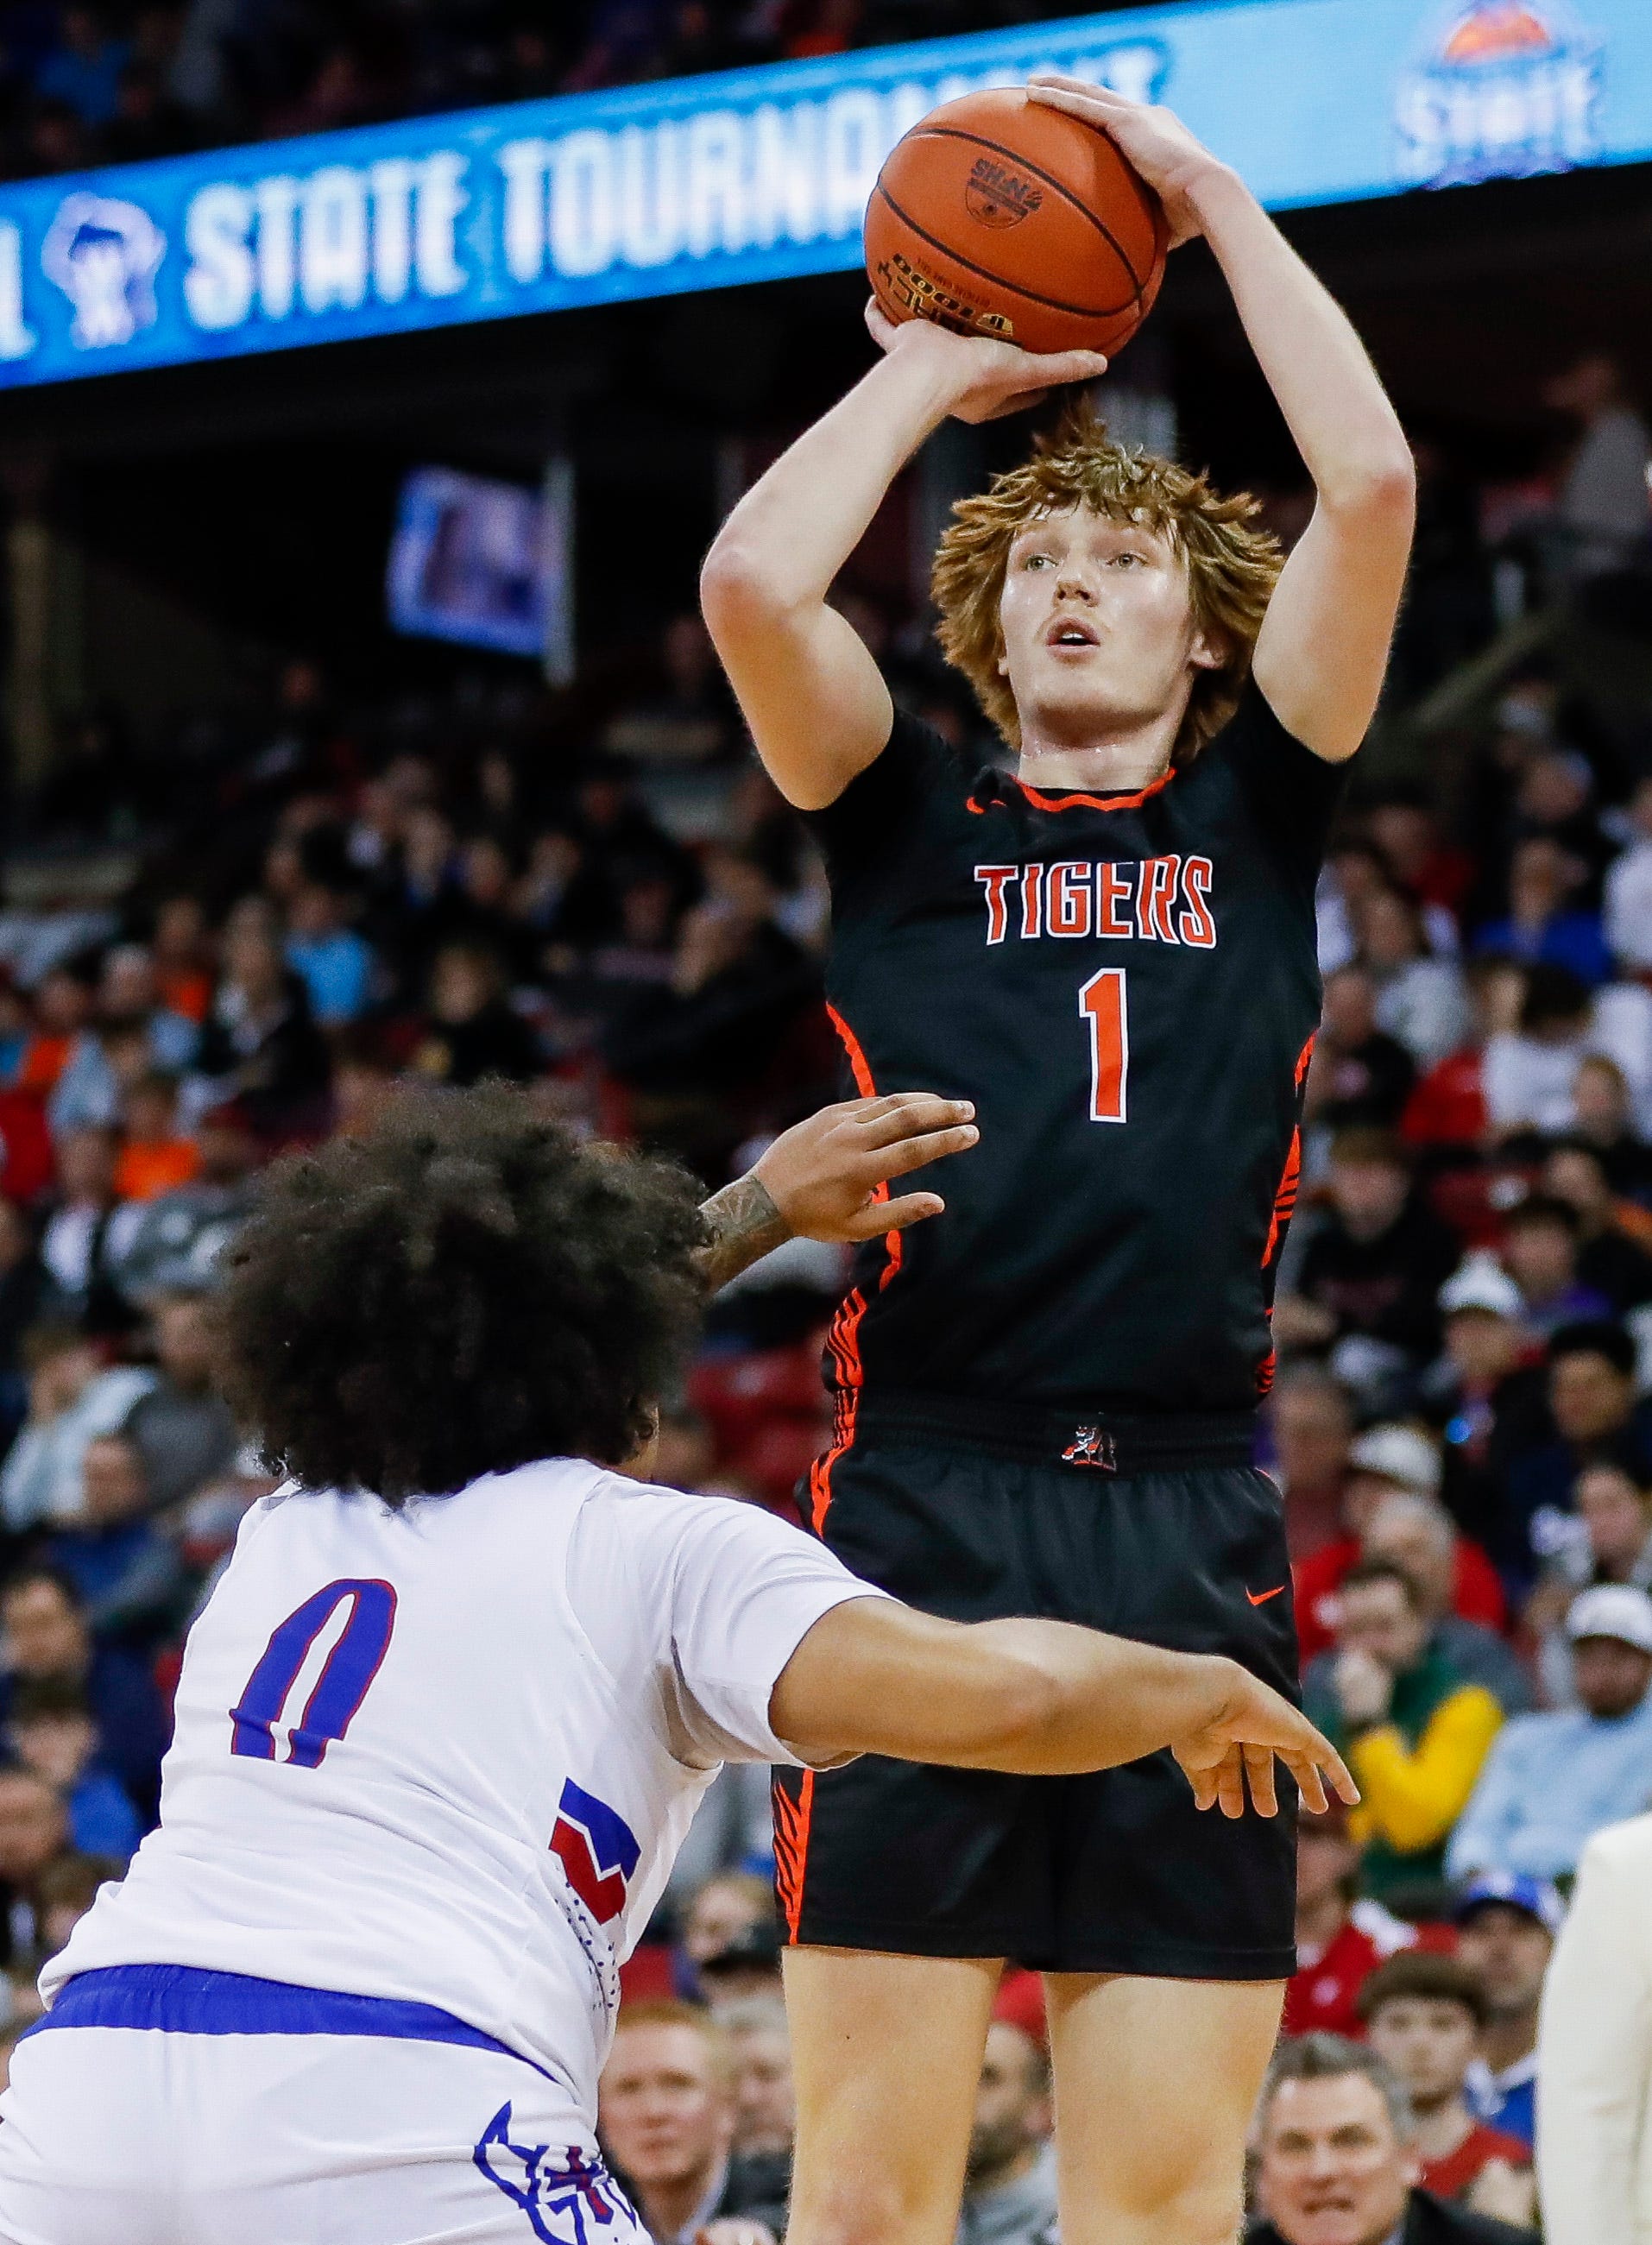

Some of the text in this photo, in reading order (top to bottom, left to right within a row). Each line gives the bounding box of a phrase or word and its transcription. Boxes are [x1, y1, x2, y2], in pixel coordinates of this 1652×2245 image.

[182, 148, 470, 335] STATE
[974, 854, 1217, 949] TIGERS
[1078, 968, 1130, 1124] 1
[230, 1579, 398, 1769] 0
